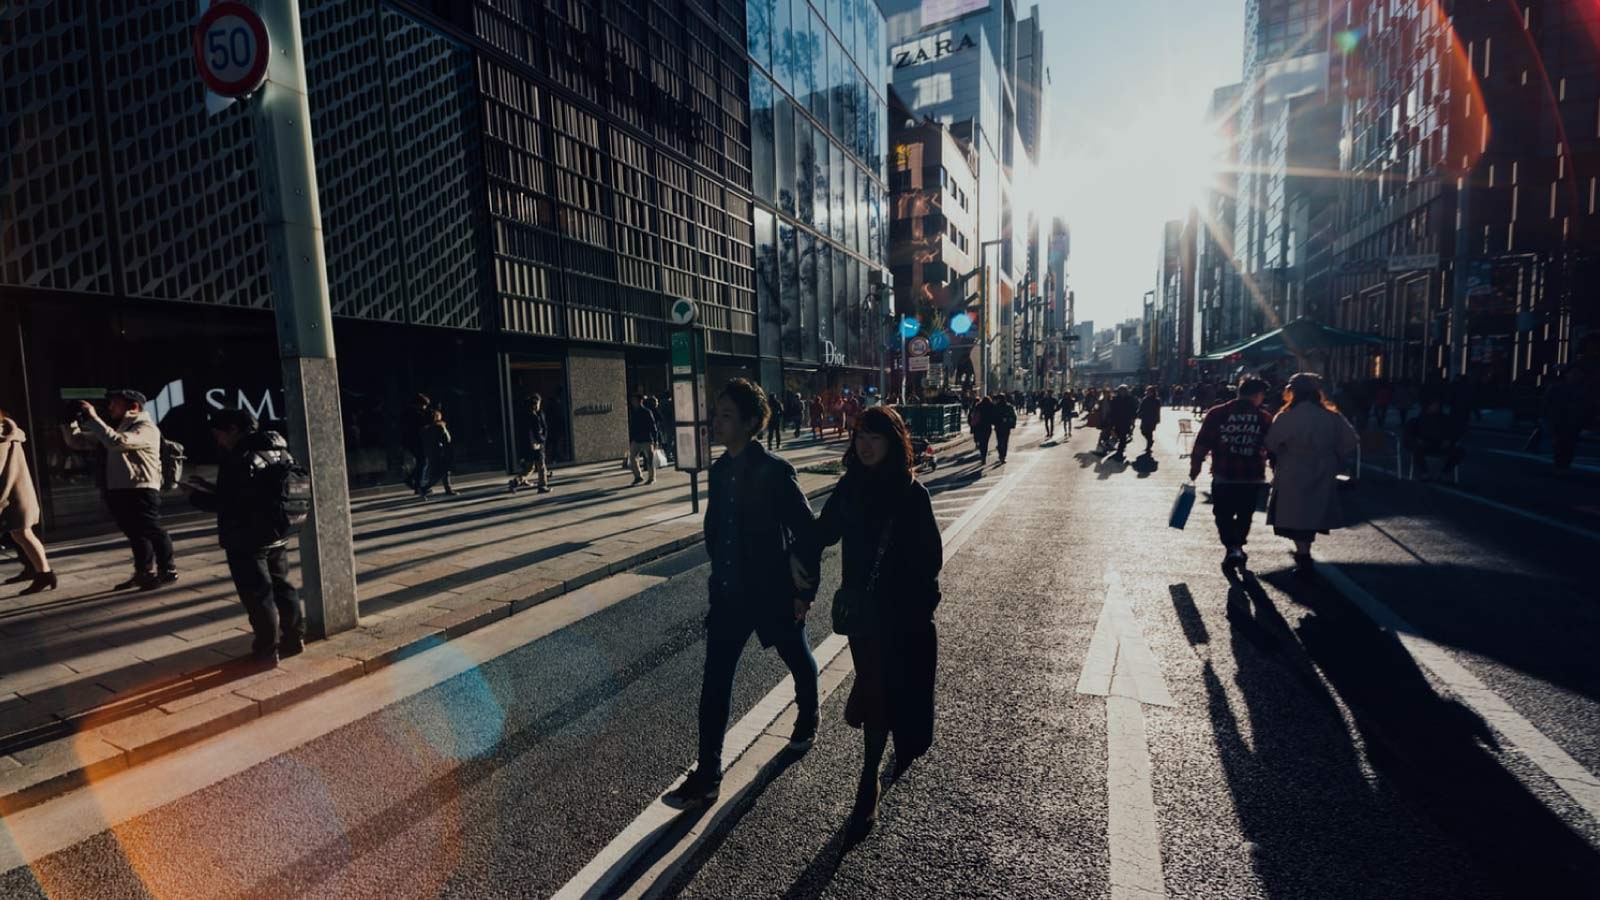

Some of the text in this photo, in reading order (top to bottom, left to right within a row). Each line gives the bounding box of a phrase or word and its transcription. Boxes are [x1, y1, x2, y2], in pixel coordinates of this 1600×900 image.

[208, 28, 251, 70] 50
[896, 33, 976, 69] ZARA
[823, 340, 845, 365] Dior
[205, 388, 283, 421] SM
[1228, 413, 1259, 423] ANTI
[1220, 424, 1262, 434] SOCIAL
